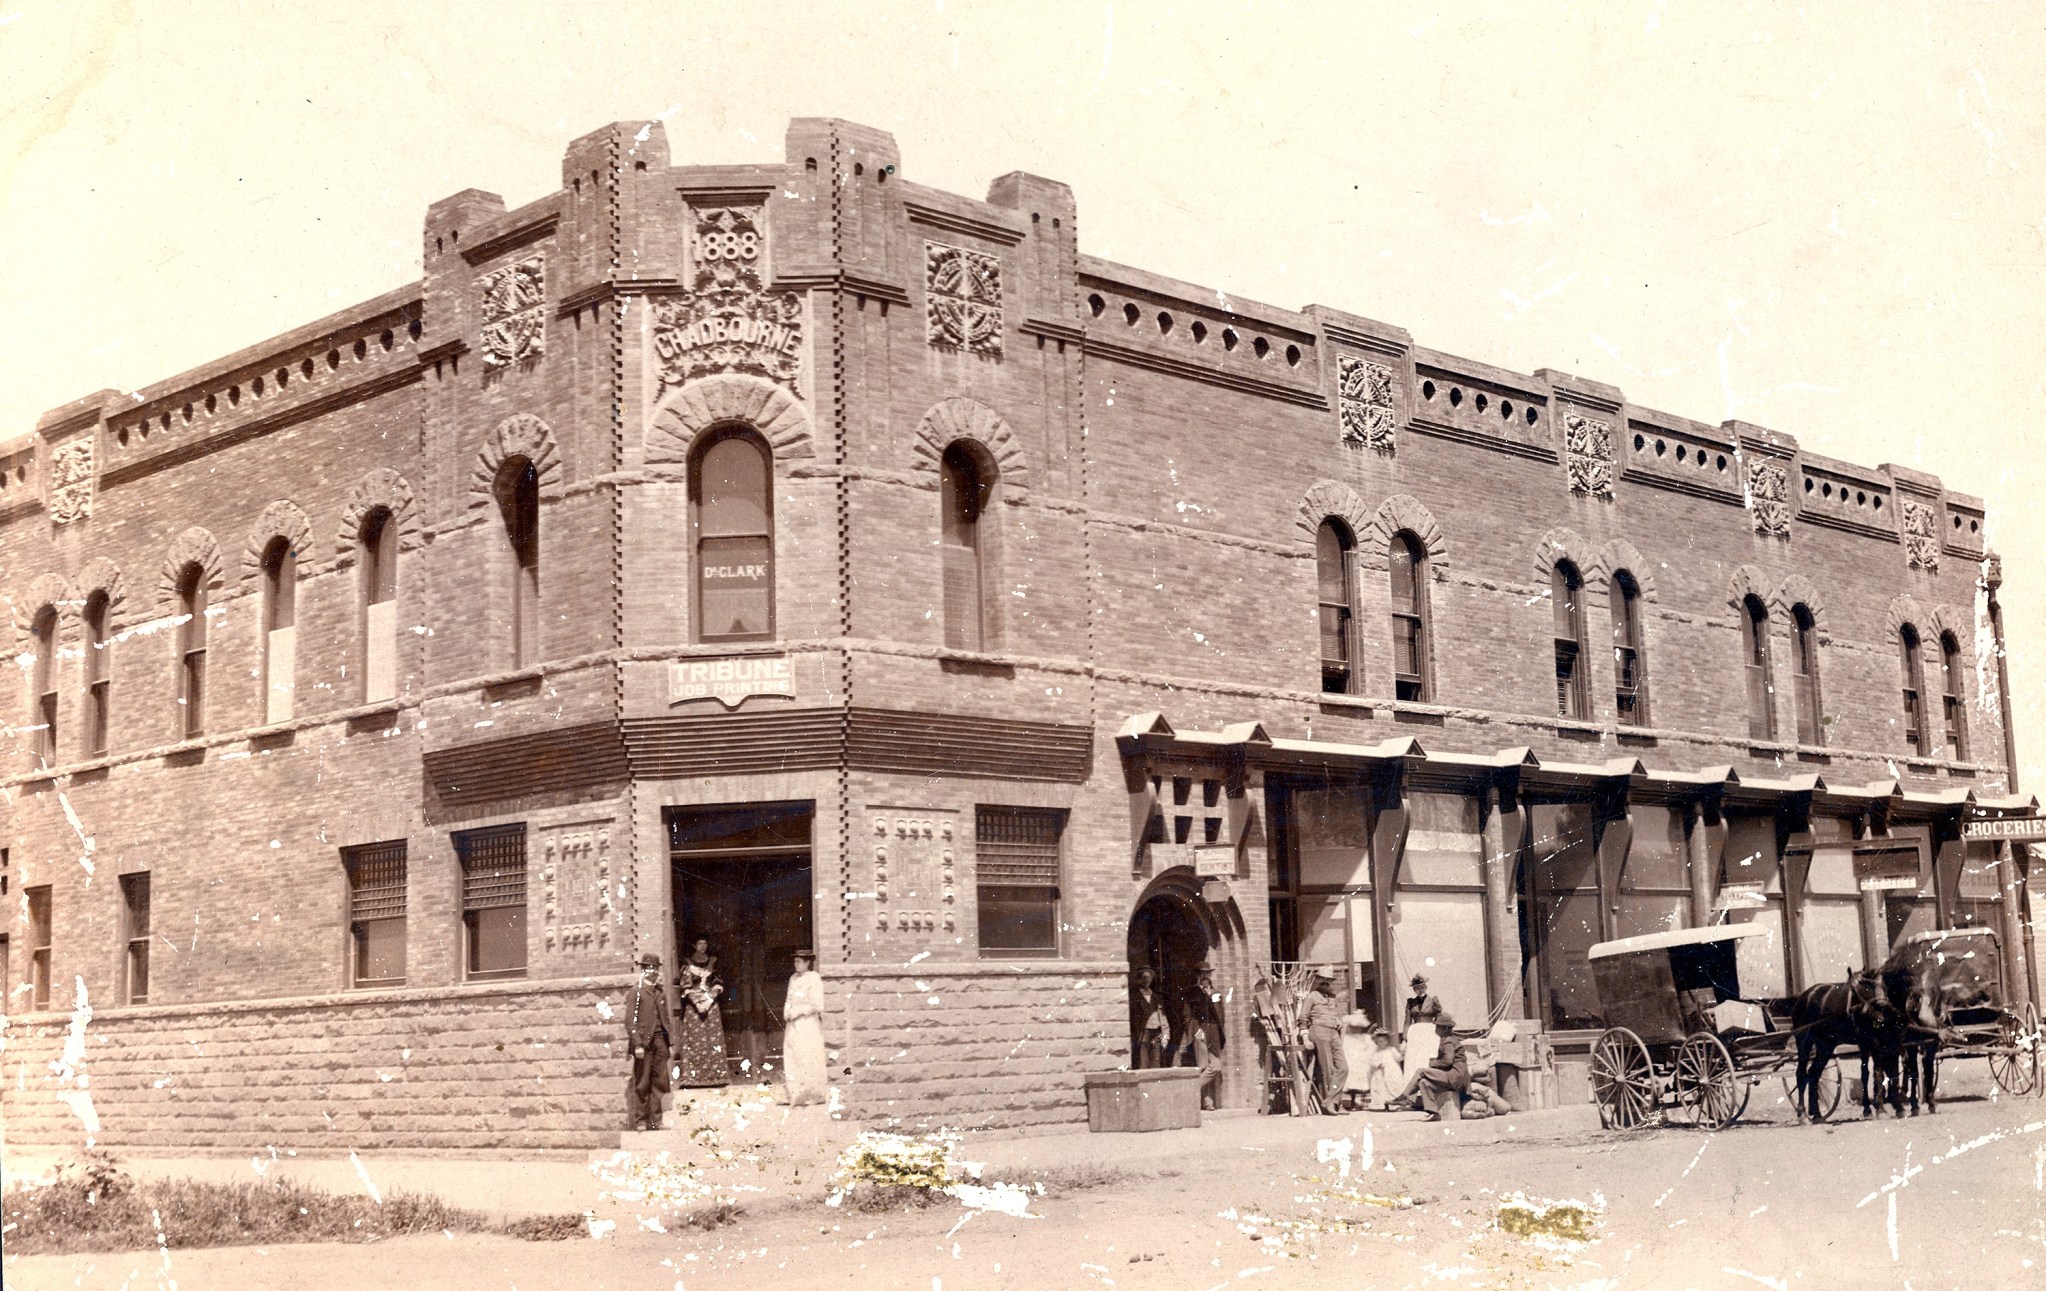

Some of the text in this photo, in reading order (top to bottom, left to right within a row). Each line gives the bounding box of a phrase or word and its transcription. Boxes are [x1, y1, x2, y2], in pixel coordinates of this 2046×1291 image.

[695, 231, 759, 261] 1888
[655, 316, 803, 359] CHADBOURNE
[672, 659, 791, 683] TRIBUNE
[674, 680, 789, 697] JOB PRINTING
